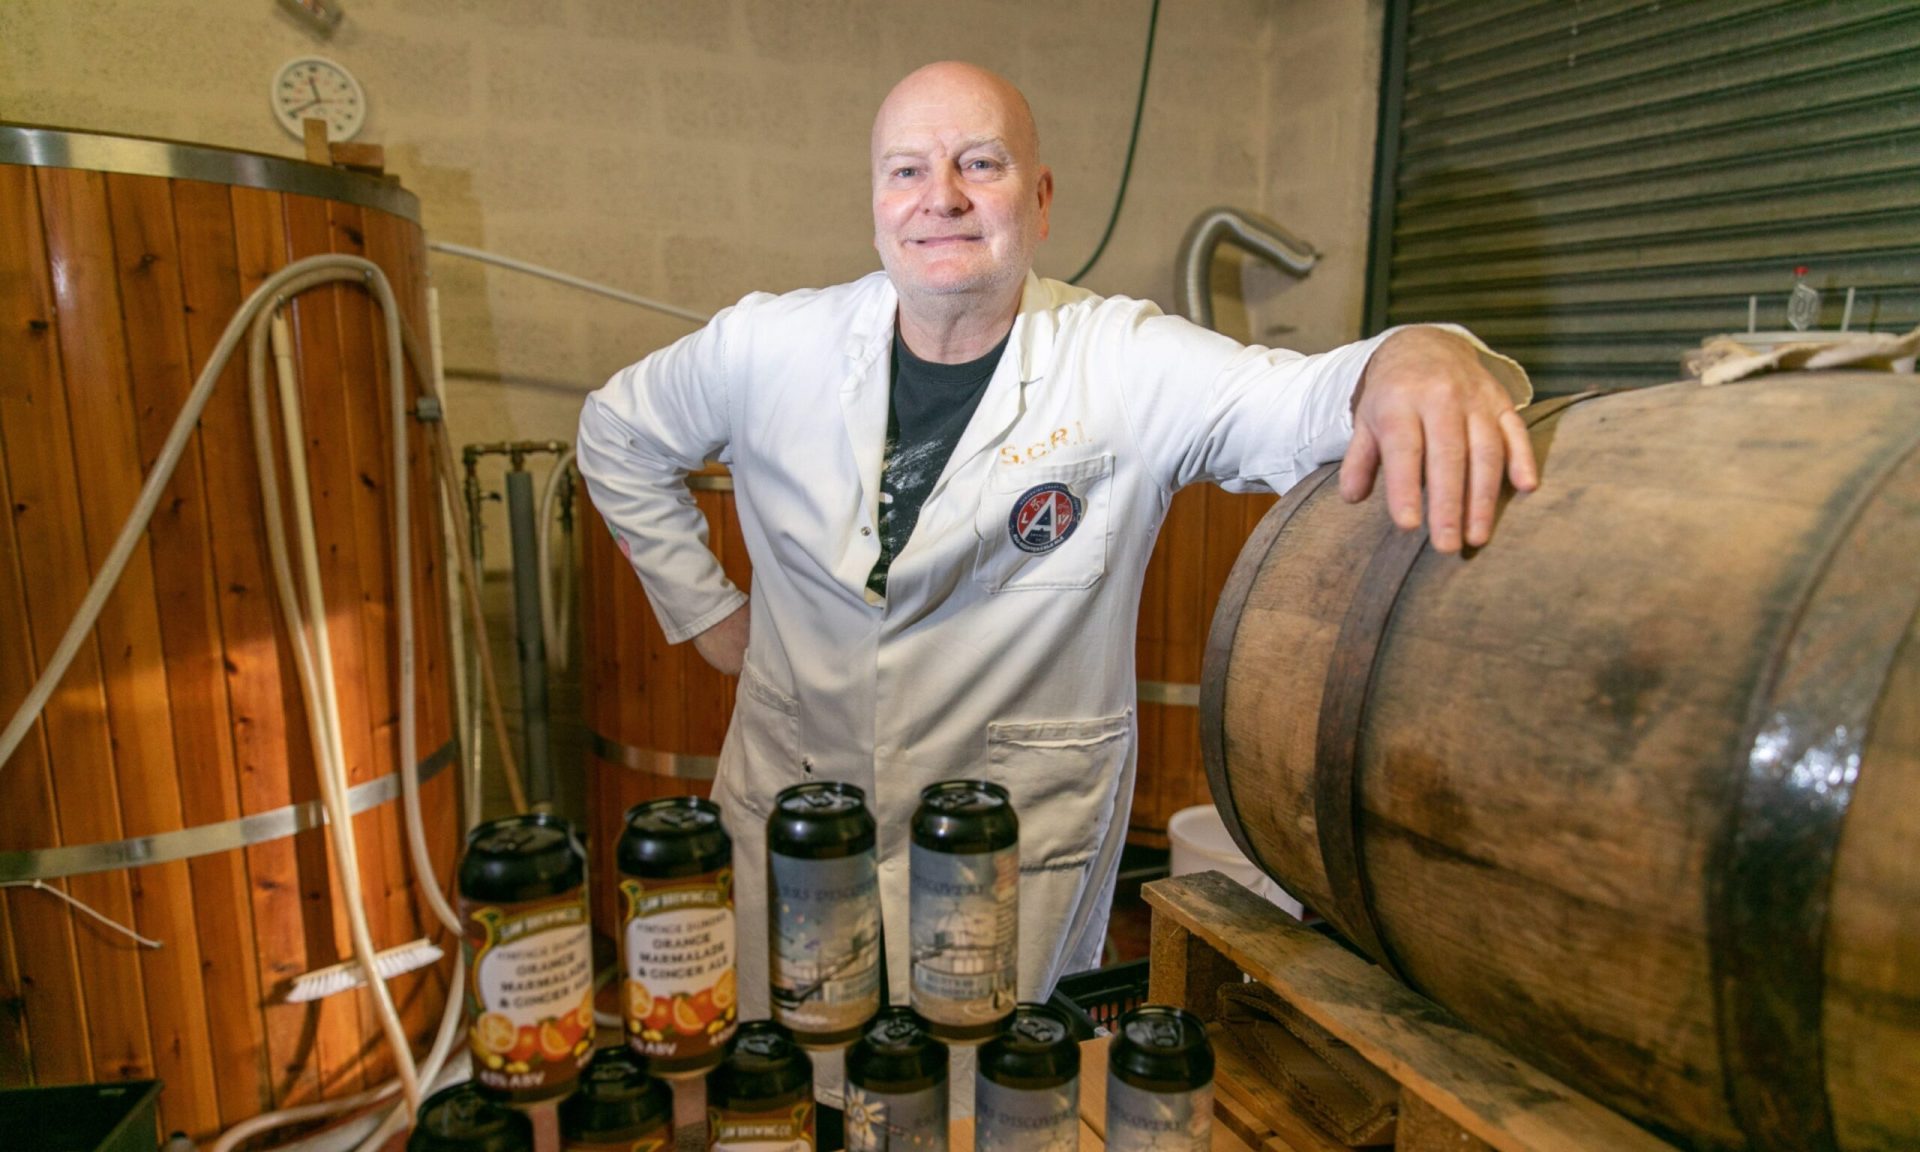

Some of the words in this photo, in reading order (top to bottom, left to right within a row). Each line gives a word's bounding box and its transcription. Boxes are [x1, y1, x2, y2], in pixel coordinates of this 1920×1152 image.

[639, 941, 726, 963] MARMALADE
[652, 932, 711, 949] ORANGE
[516, 951, 576, 976] ORANGE
[638, 966, 648, 977] &
[650, 965, 706, 980] GINGER
[709, 954, 729, 972] ALE
[499, 997, 511, 1009] &
[514, 986, 570, 1010] GINGER
